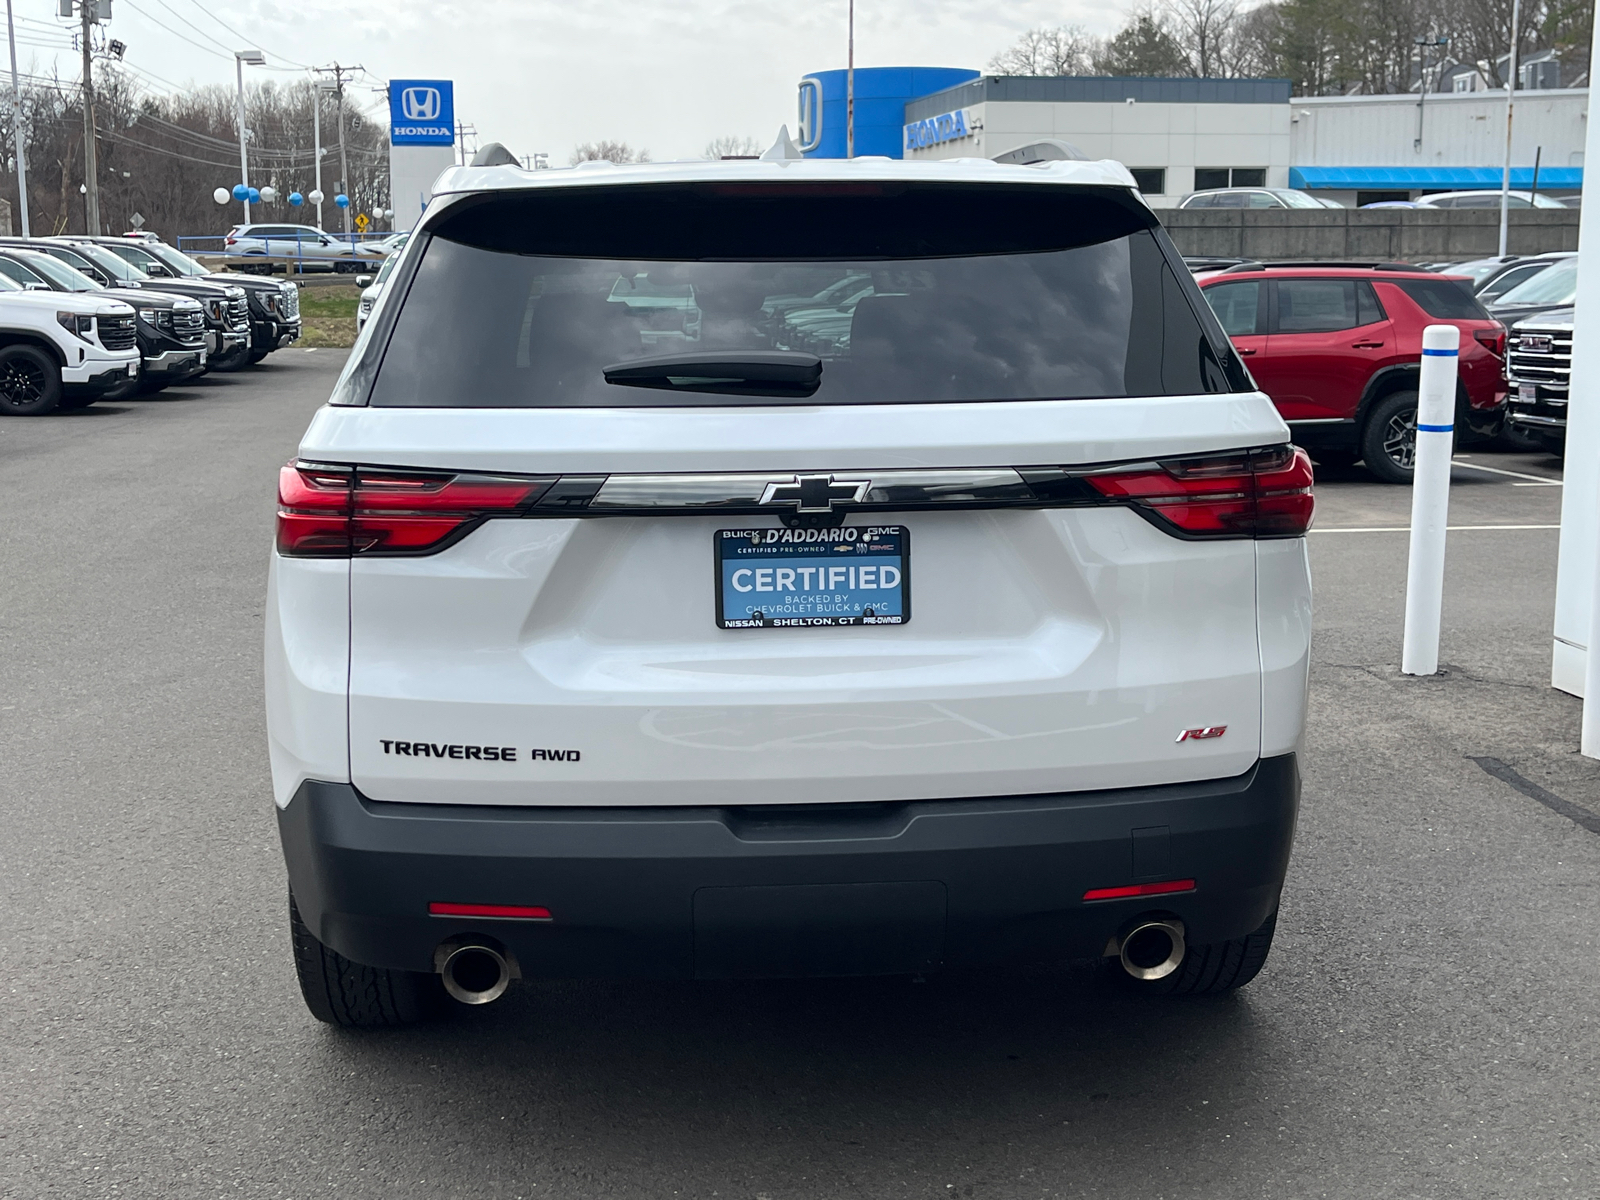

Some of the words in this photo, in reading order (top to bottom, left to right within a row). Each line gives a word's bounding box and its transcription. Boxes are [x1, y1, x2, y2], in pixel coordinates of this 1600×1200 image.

[394, 127, 451, 136] HONDA
[906, 109, 967, 150] HONDA
[722, 530, 760, 539] BUICK
[766, 527, 858, 544] D'ADDARIO
[867, 527, 899, 535] GMC
[731, 565, 901, 593] CERTIFIED
[785, 595, 830, 604] BACKED
[835, 594, 849, 603] BY
[746, 604, 812, 614] CHEVROLET
[817, 603, 850, 612] BUICK
[854, 602, 860, 611] &
[725, 620, 763, 628] NISSAN
[773, 617, 835, 626] SHELTON,
[838, 617, 856, 625] CT
[863, 616, 902, 624] PRE-OWNED
[1175, 725, 1228, 743] RS
[380, 739, 517, 761] TRAVERSE
[531, 749, 581, 762] AWD
